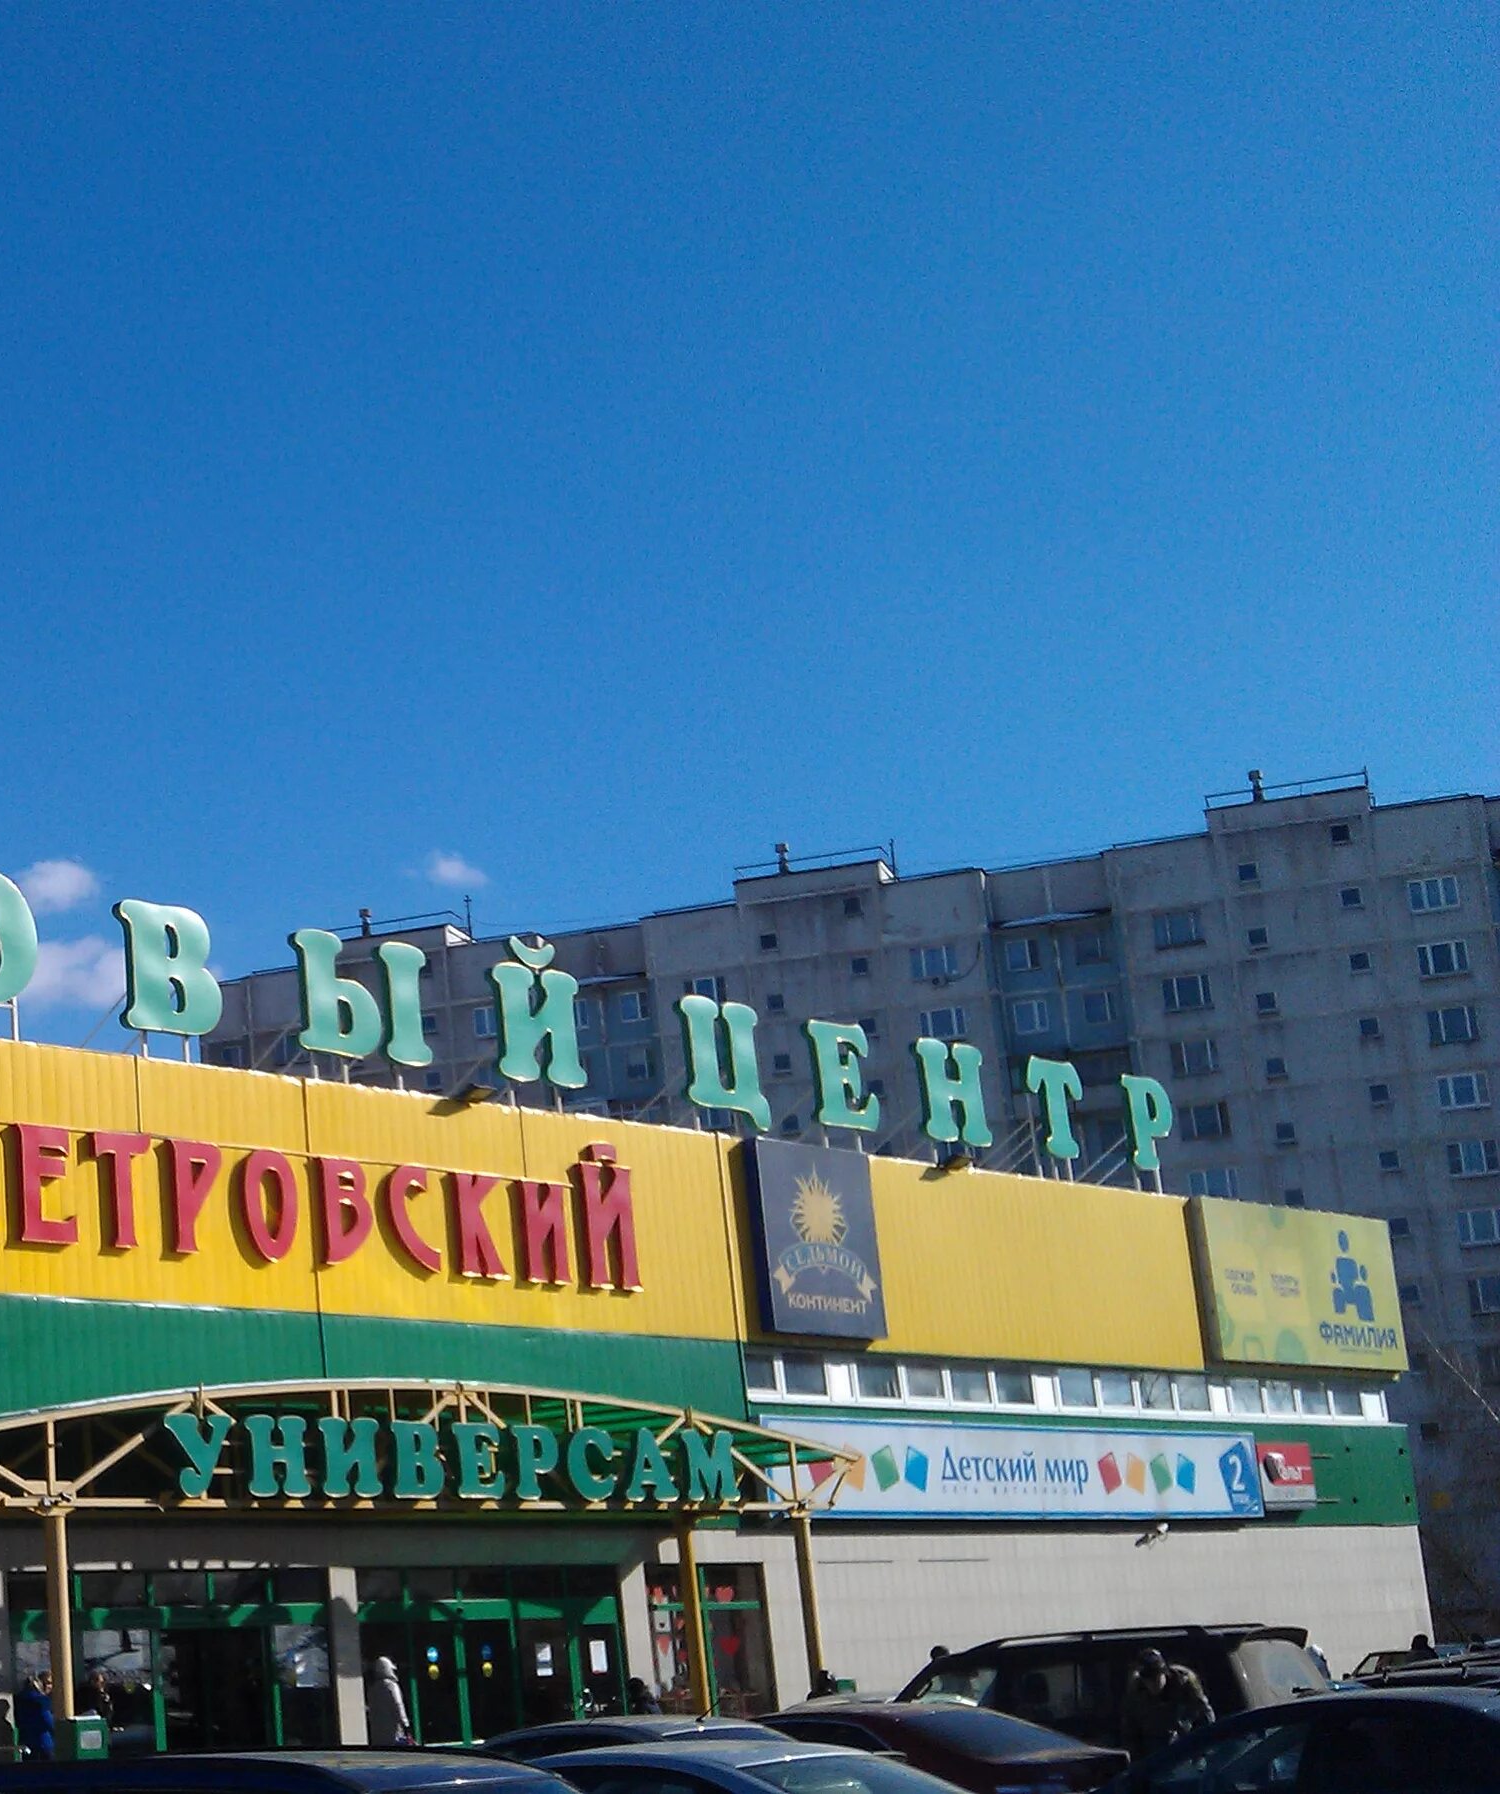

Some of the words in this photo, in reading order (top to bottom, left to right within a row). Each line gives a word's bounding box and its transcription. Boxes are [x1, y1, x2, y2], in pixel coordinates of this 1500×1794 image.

[676, 995, 1173, 1170] ЦЕНТР
[787, 1292, 869, 1315] КОНТИНЕНТ
[1319, 1320, 1398, 1350] ФАМИЛИЯ
[163, 1413, 742, 1502] УНИВЕРСАМ
[941, 1446, 1037, 1483] Детский
[1044, 1458, 1090, 1495] мир
[1228, 1454, 1246, 1492] 2
